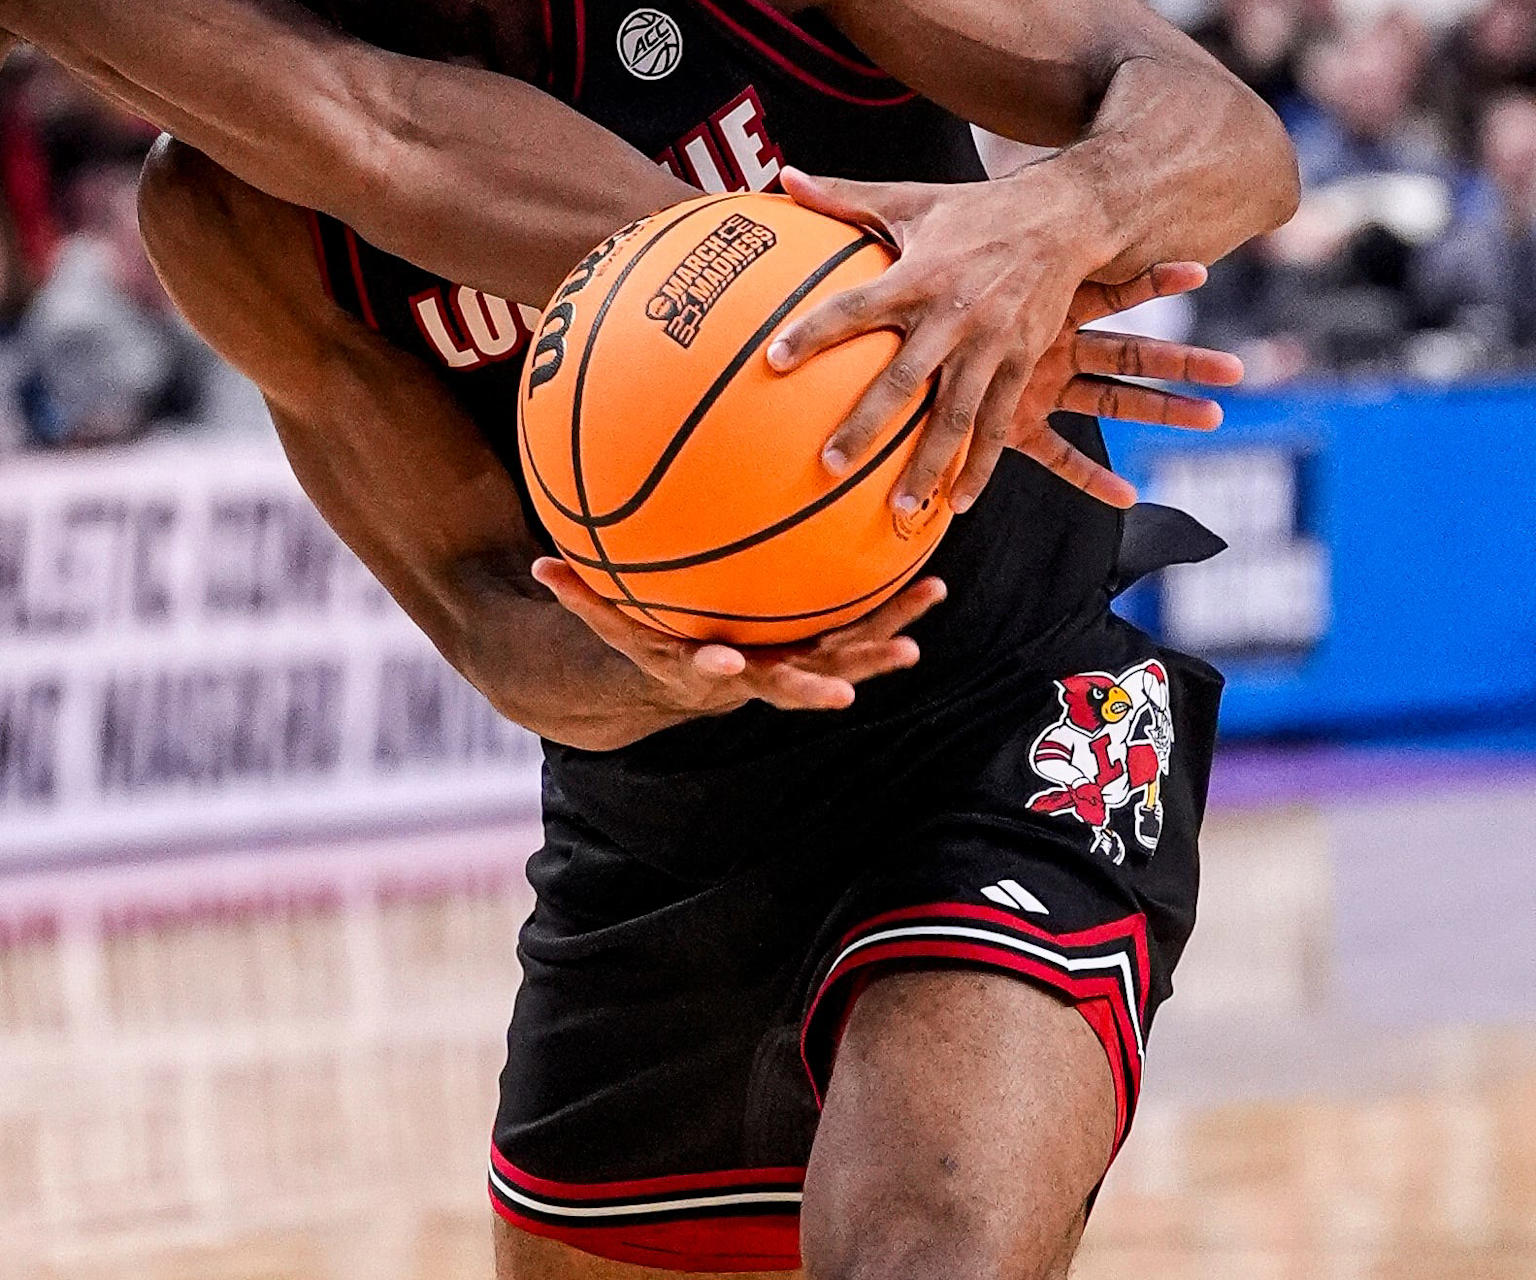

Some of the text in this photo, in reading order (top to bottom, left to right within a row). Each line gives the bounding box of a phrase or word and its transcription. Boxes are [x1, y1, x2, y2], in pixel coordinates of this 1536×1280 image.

[632, 17, 672, 63] ACC
[661, 233, 729, 300] MARCH
[686, 224, 776, 304] MADNESS
